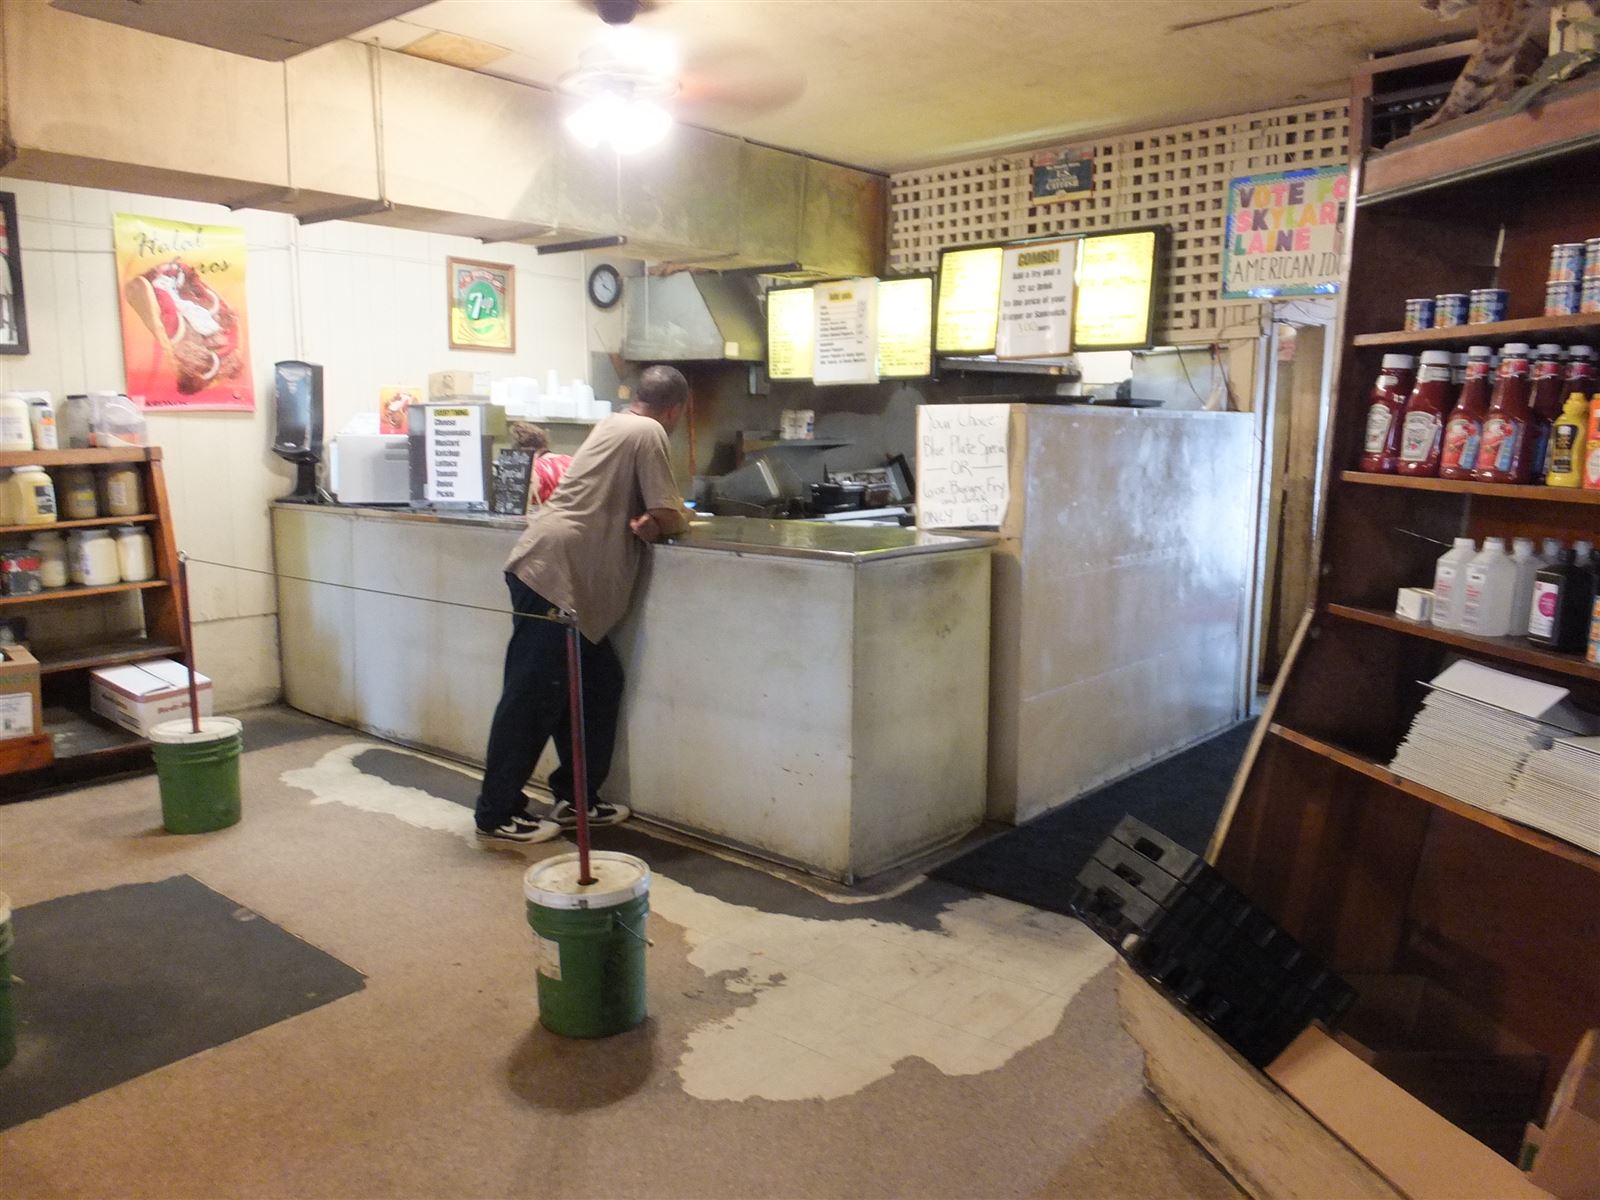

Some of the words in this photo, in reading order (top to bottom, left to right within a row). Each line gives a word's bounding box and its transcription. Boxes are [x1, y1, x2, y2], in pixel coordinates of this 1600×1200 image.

[1238, 181, 1305, 209] VOTE
[1318, 174, 1349, 204] FO
[1235, 200, 1337, 233] SKYLAR
[1233, 227, 1312, 256] LAINE
[1018, 249, 1060, 267] COMBO!
[1231, 253, 1315, 284] AMERICAN
